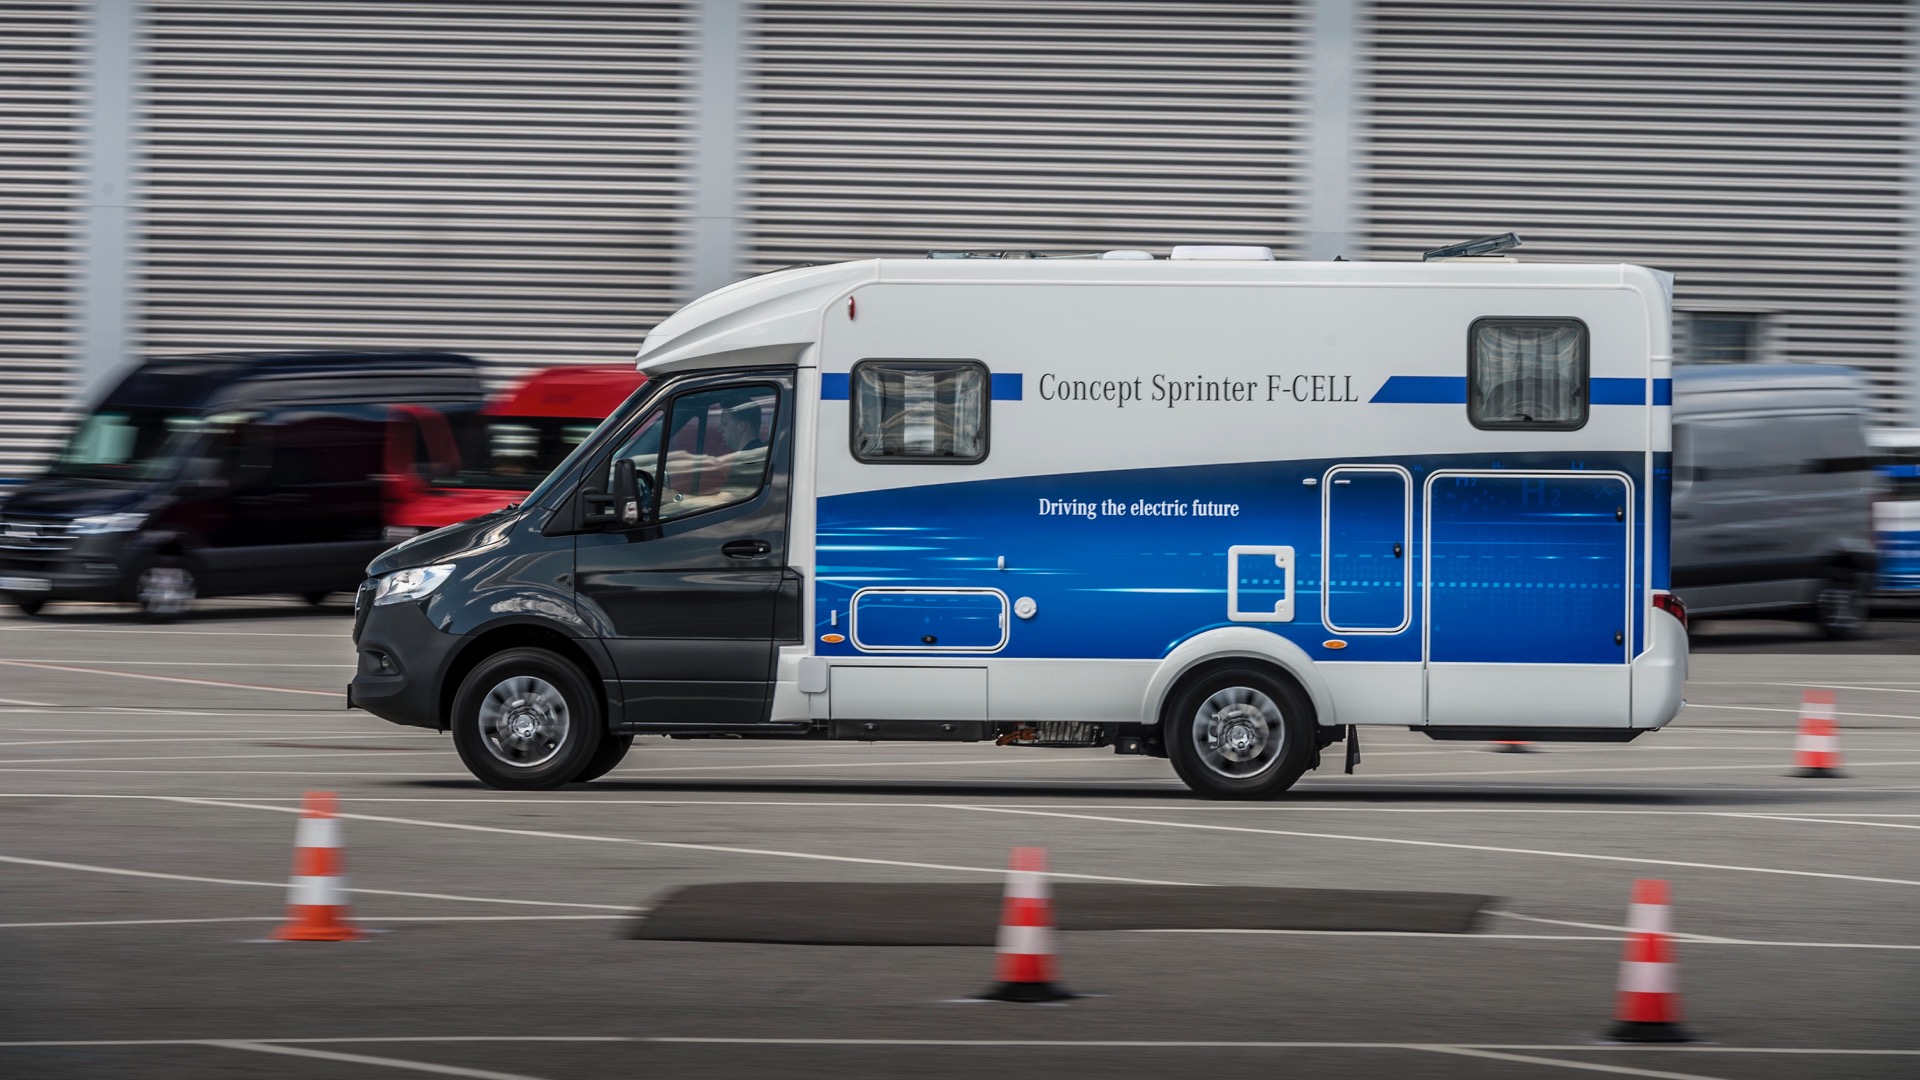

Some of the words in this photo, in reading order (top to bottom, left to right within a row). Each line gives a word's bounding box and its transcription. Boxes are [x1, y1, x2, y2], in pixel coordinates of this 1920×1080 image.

[1039, 373, 1142, 408] Concept
[1151, 374, 1258, 408] Sprinter
[1266, 374, 1359, 402] F-CELL
[1038, 498, 1097, 519] Driving
[1101, 498, 1126, 516] the
[1130, 498, 1188, 516] electric
[1191, 499, 1240, 516] future
